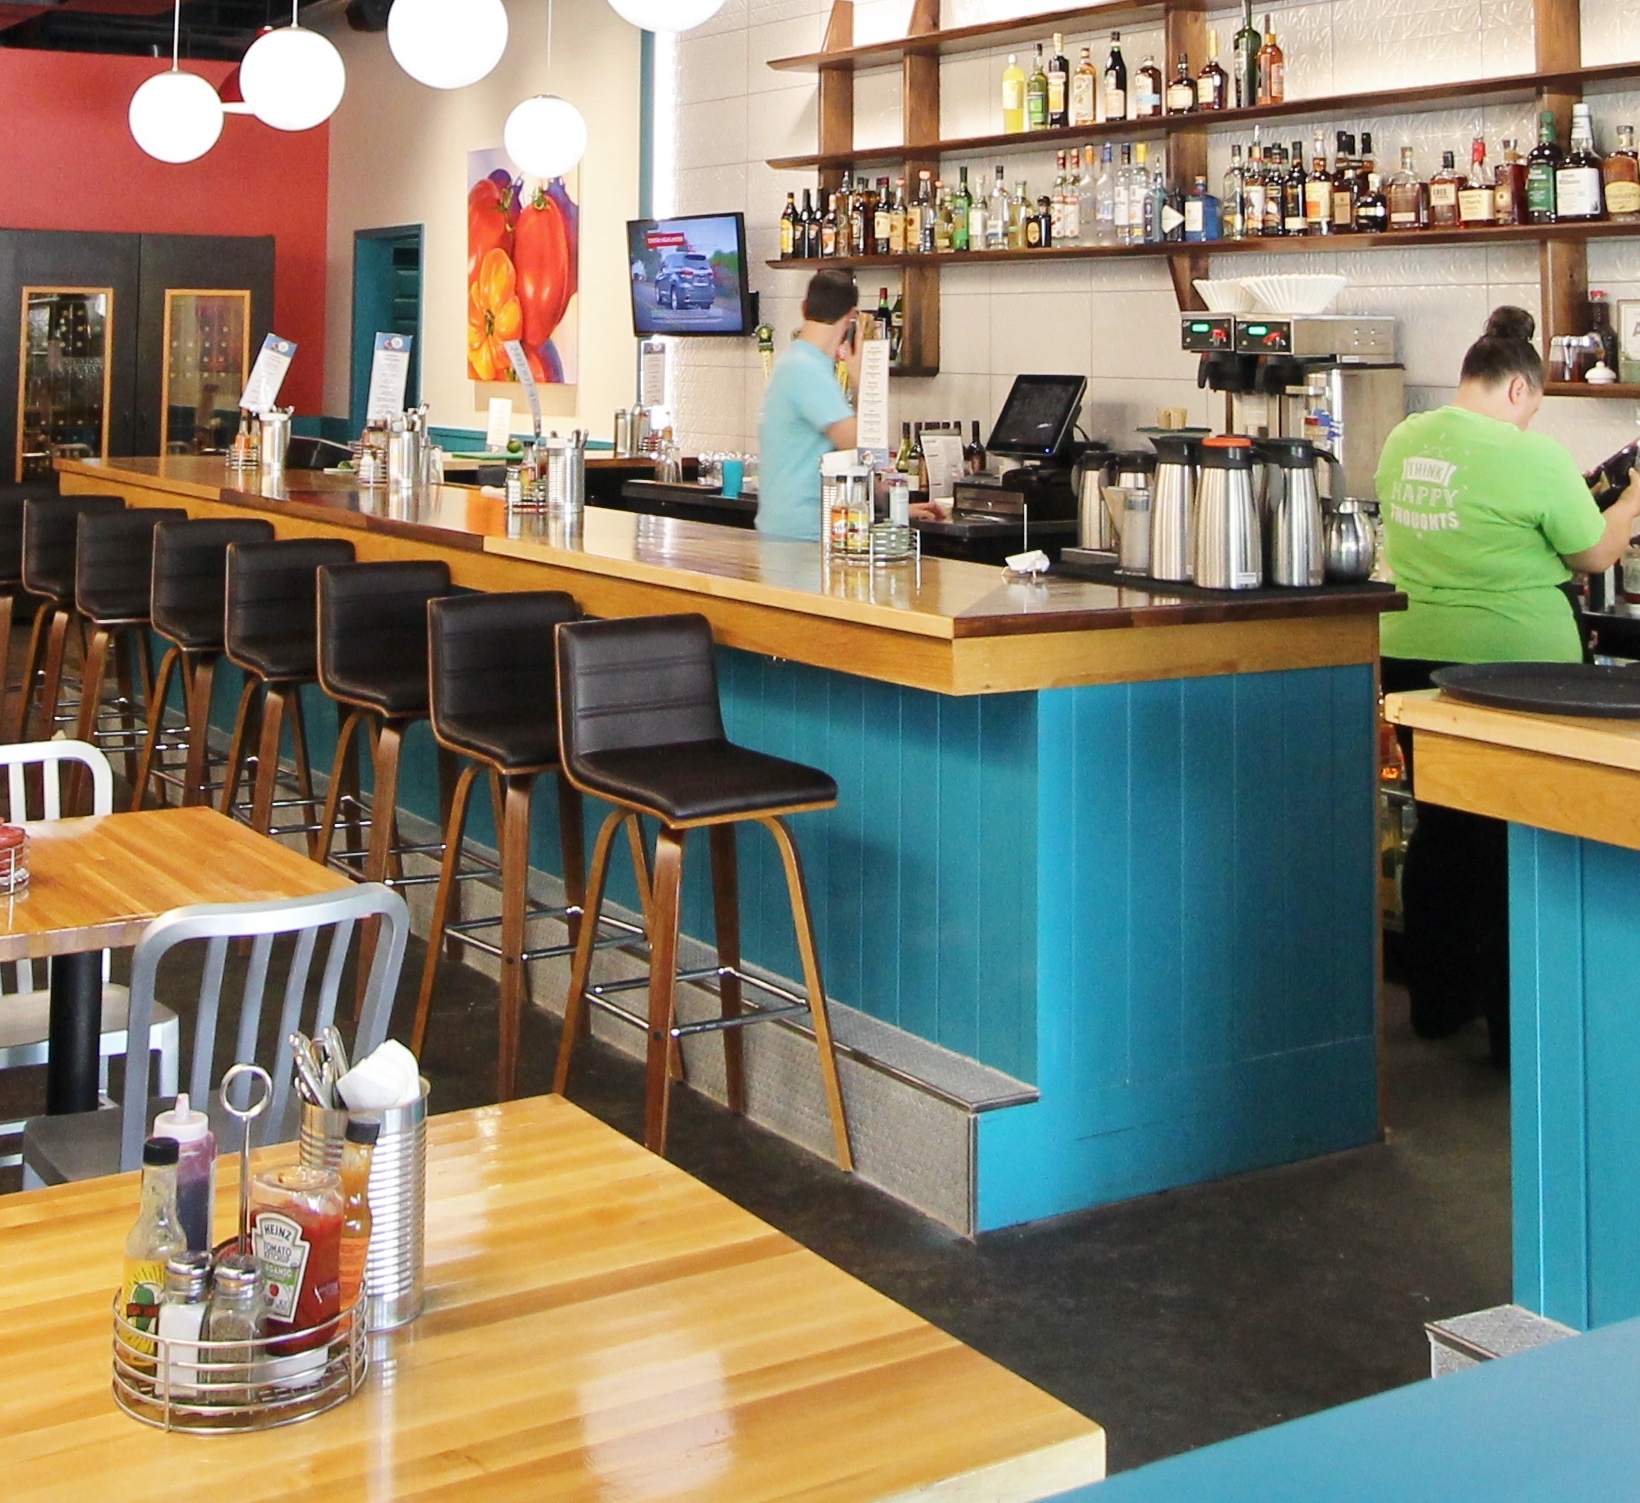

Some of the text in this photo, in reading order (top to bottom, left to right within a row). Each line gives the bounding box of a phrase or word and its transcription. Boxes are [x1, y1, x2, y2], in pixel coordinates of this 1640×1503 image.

[1407, 462, 1444, 478] THINK
[1391, 481, 1459, 508] HAPPY
[1390, 502, 1460, 531] THOUGHTS
[264, 1224, 292, 1241] HEINZ
[263, 1242, 292, 1256] TOMATO
